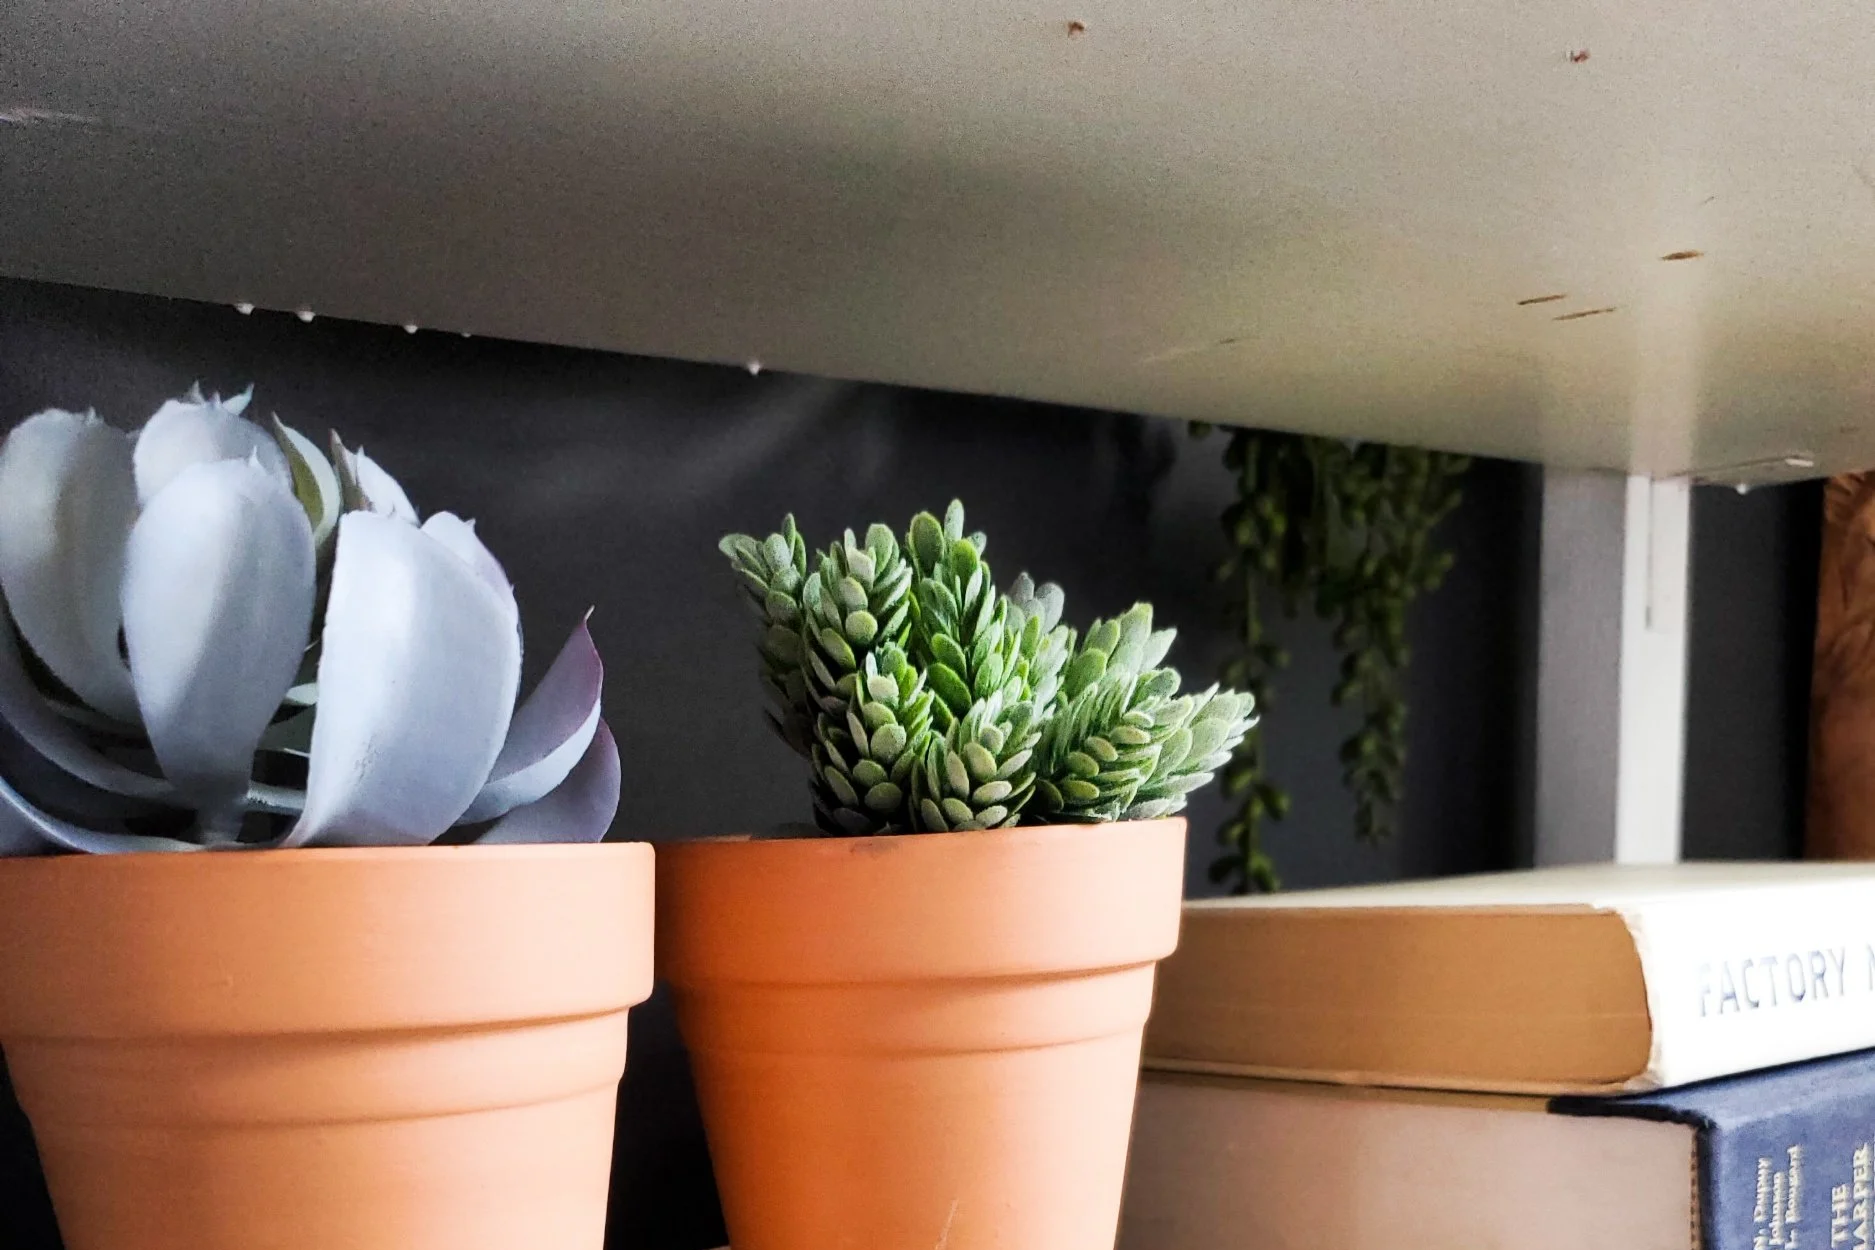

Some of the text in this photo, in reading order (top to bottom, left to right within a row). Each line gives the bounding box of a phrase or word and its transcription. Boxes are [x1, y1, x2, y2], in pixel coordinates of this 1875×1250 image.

[1696, 944, 1846, 1018] FACTORY
[1753, 1157, 1773, 1223] Dupuy
[1769, 1171, 1786, 1246] Johnson
[1831, 1184, 1849, 1249] THE
